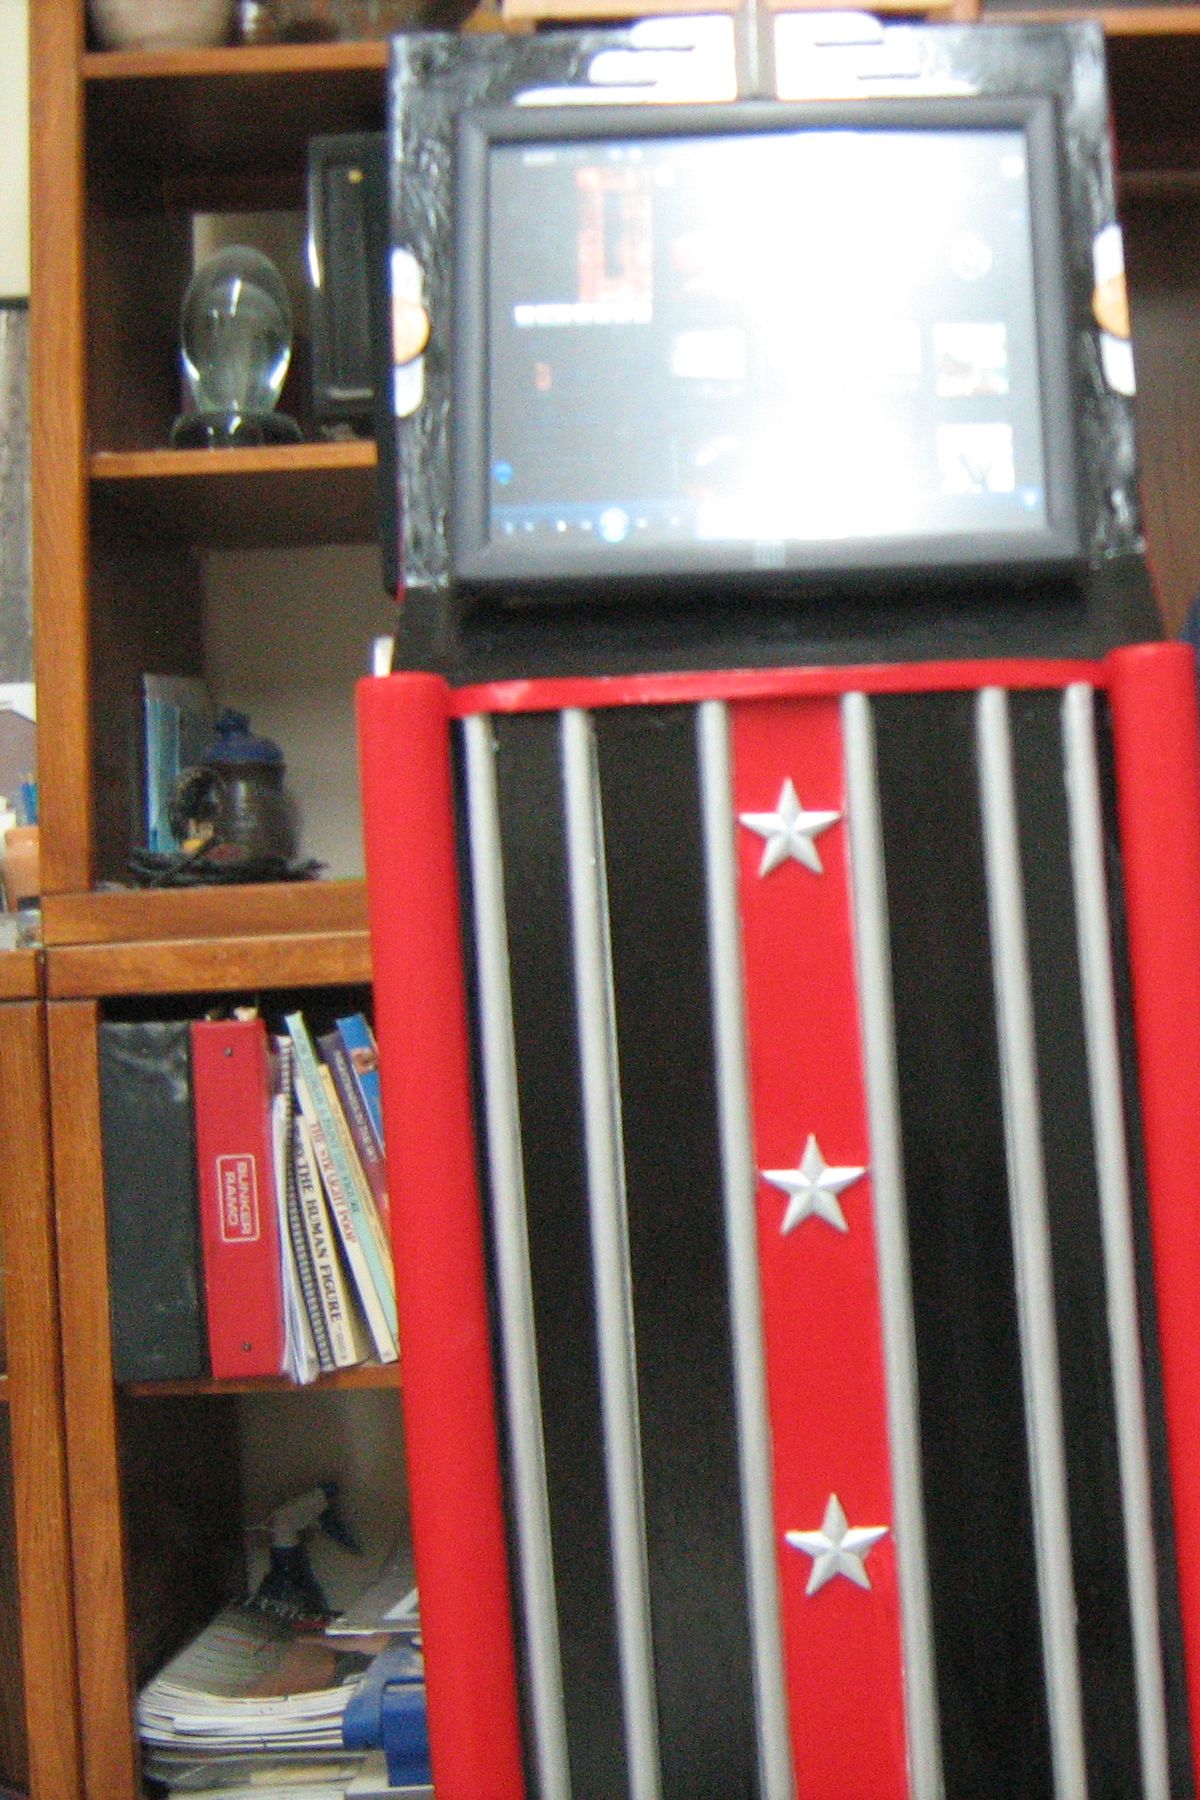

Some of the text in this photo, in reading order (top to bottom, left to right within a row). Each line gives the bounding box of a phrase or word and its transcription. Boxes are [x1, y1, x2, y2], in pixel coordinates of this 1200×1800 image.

[298, 1163, 314, 1193] THE
[305, 1199, 329, 1259] HUMAN
[319, 1263, 342, 1323] FIGURE
